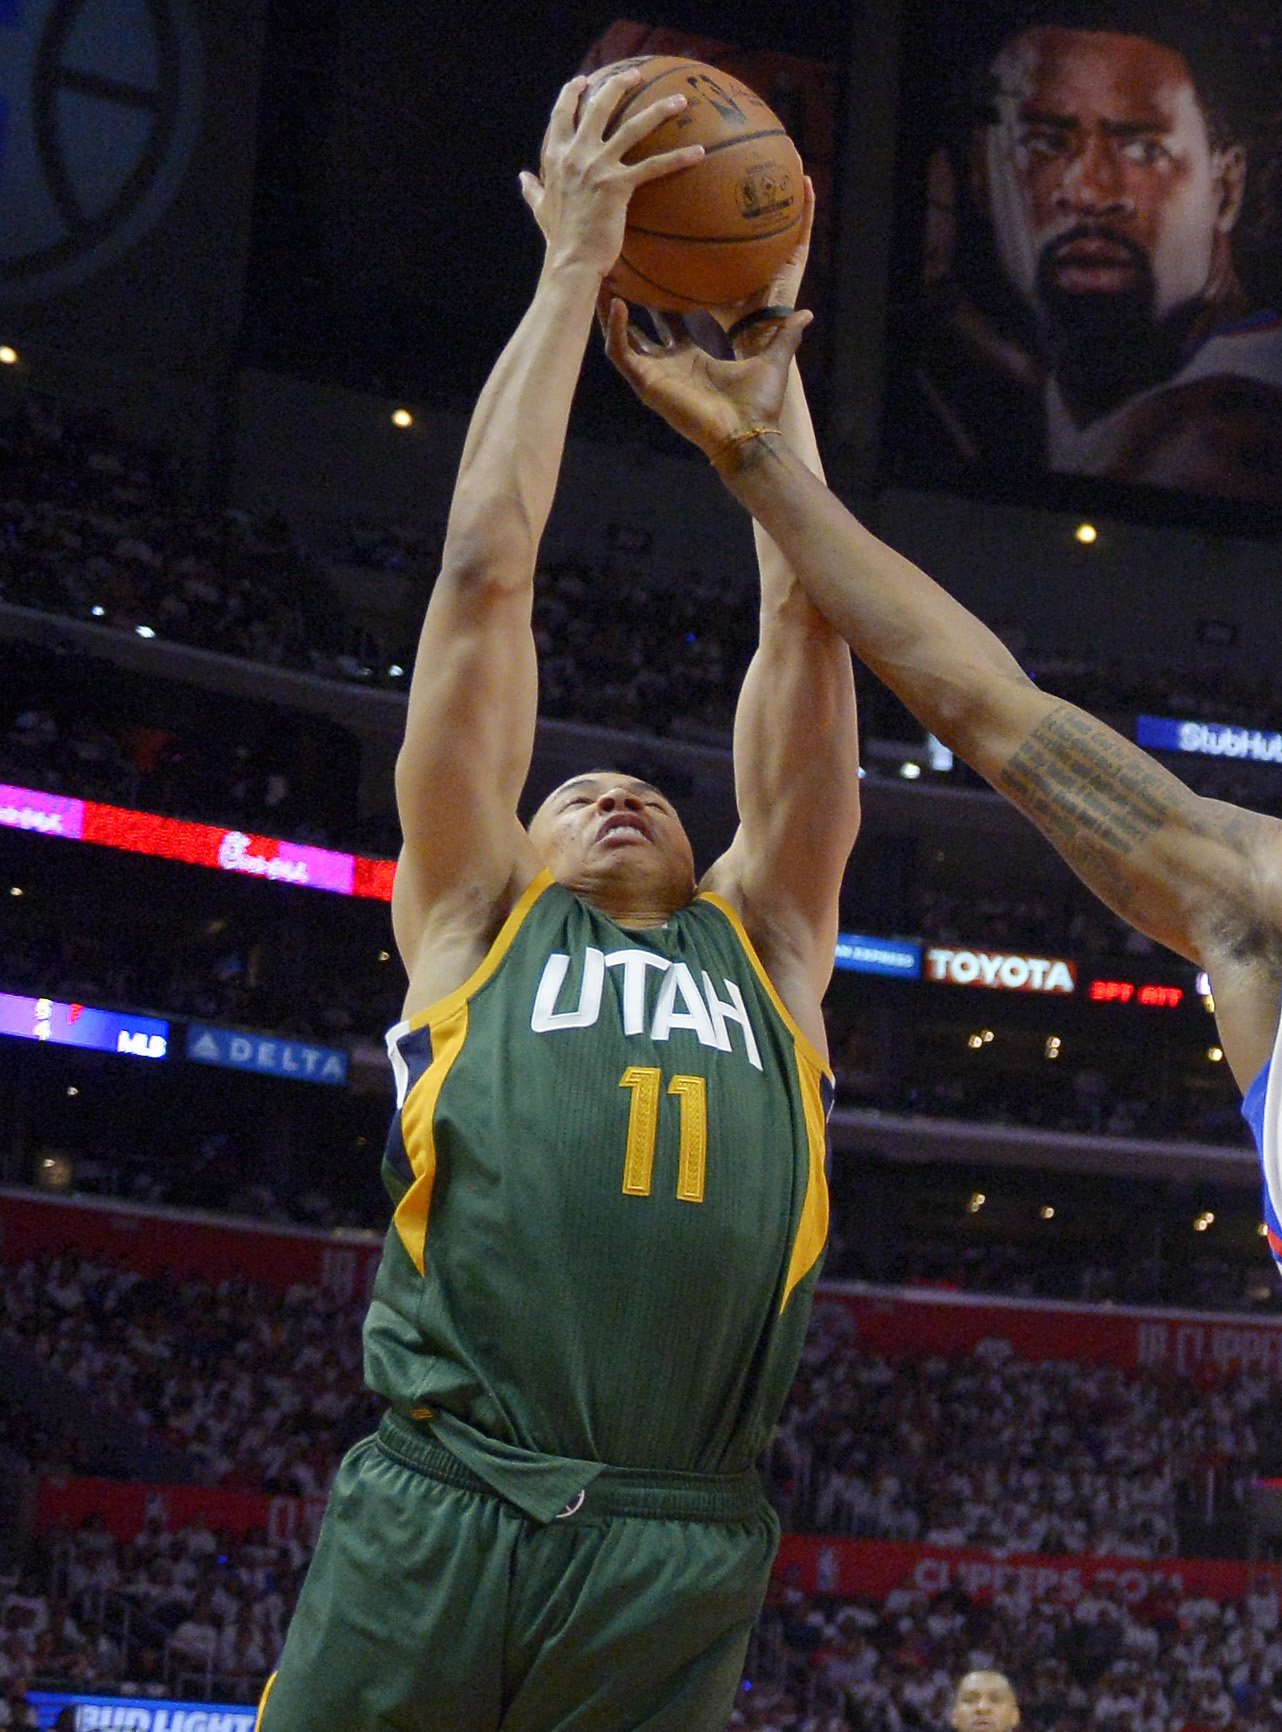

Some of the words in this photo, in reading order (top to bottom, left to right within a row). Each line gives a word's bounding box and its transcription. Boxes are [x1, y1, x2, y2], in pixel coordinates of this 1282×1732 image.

[530, 946, 764, 1072] UTAH
[928, 949, 1074, 992] TOYOTA
[229, 1036, 345, 1079] DELTA
[618, 1065, 709, 1204] 11
